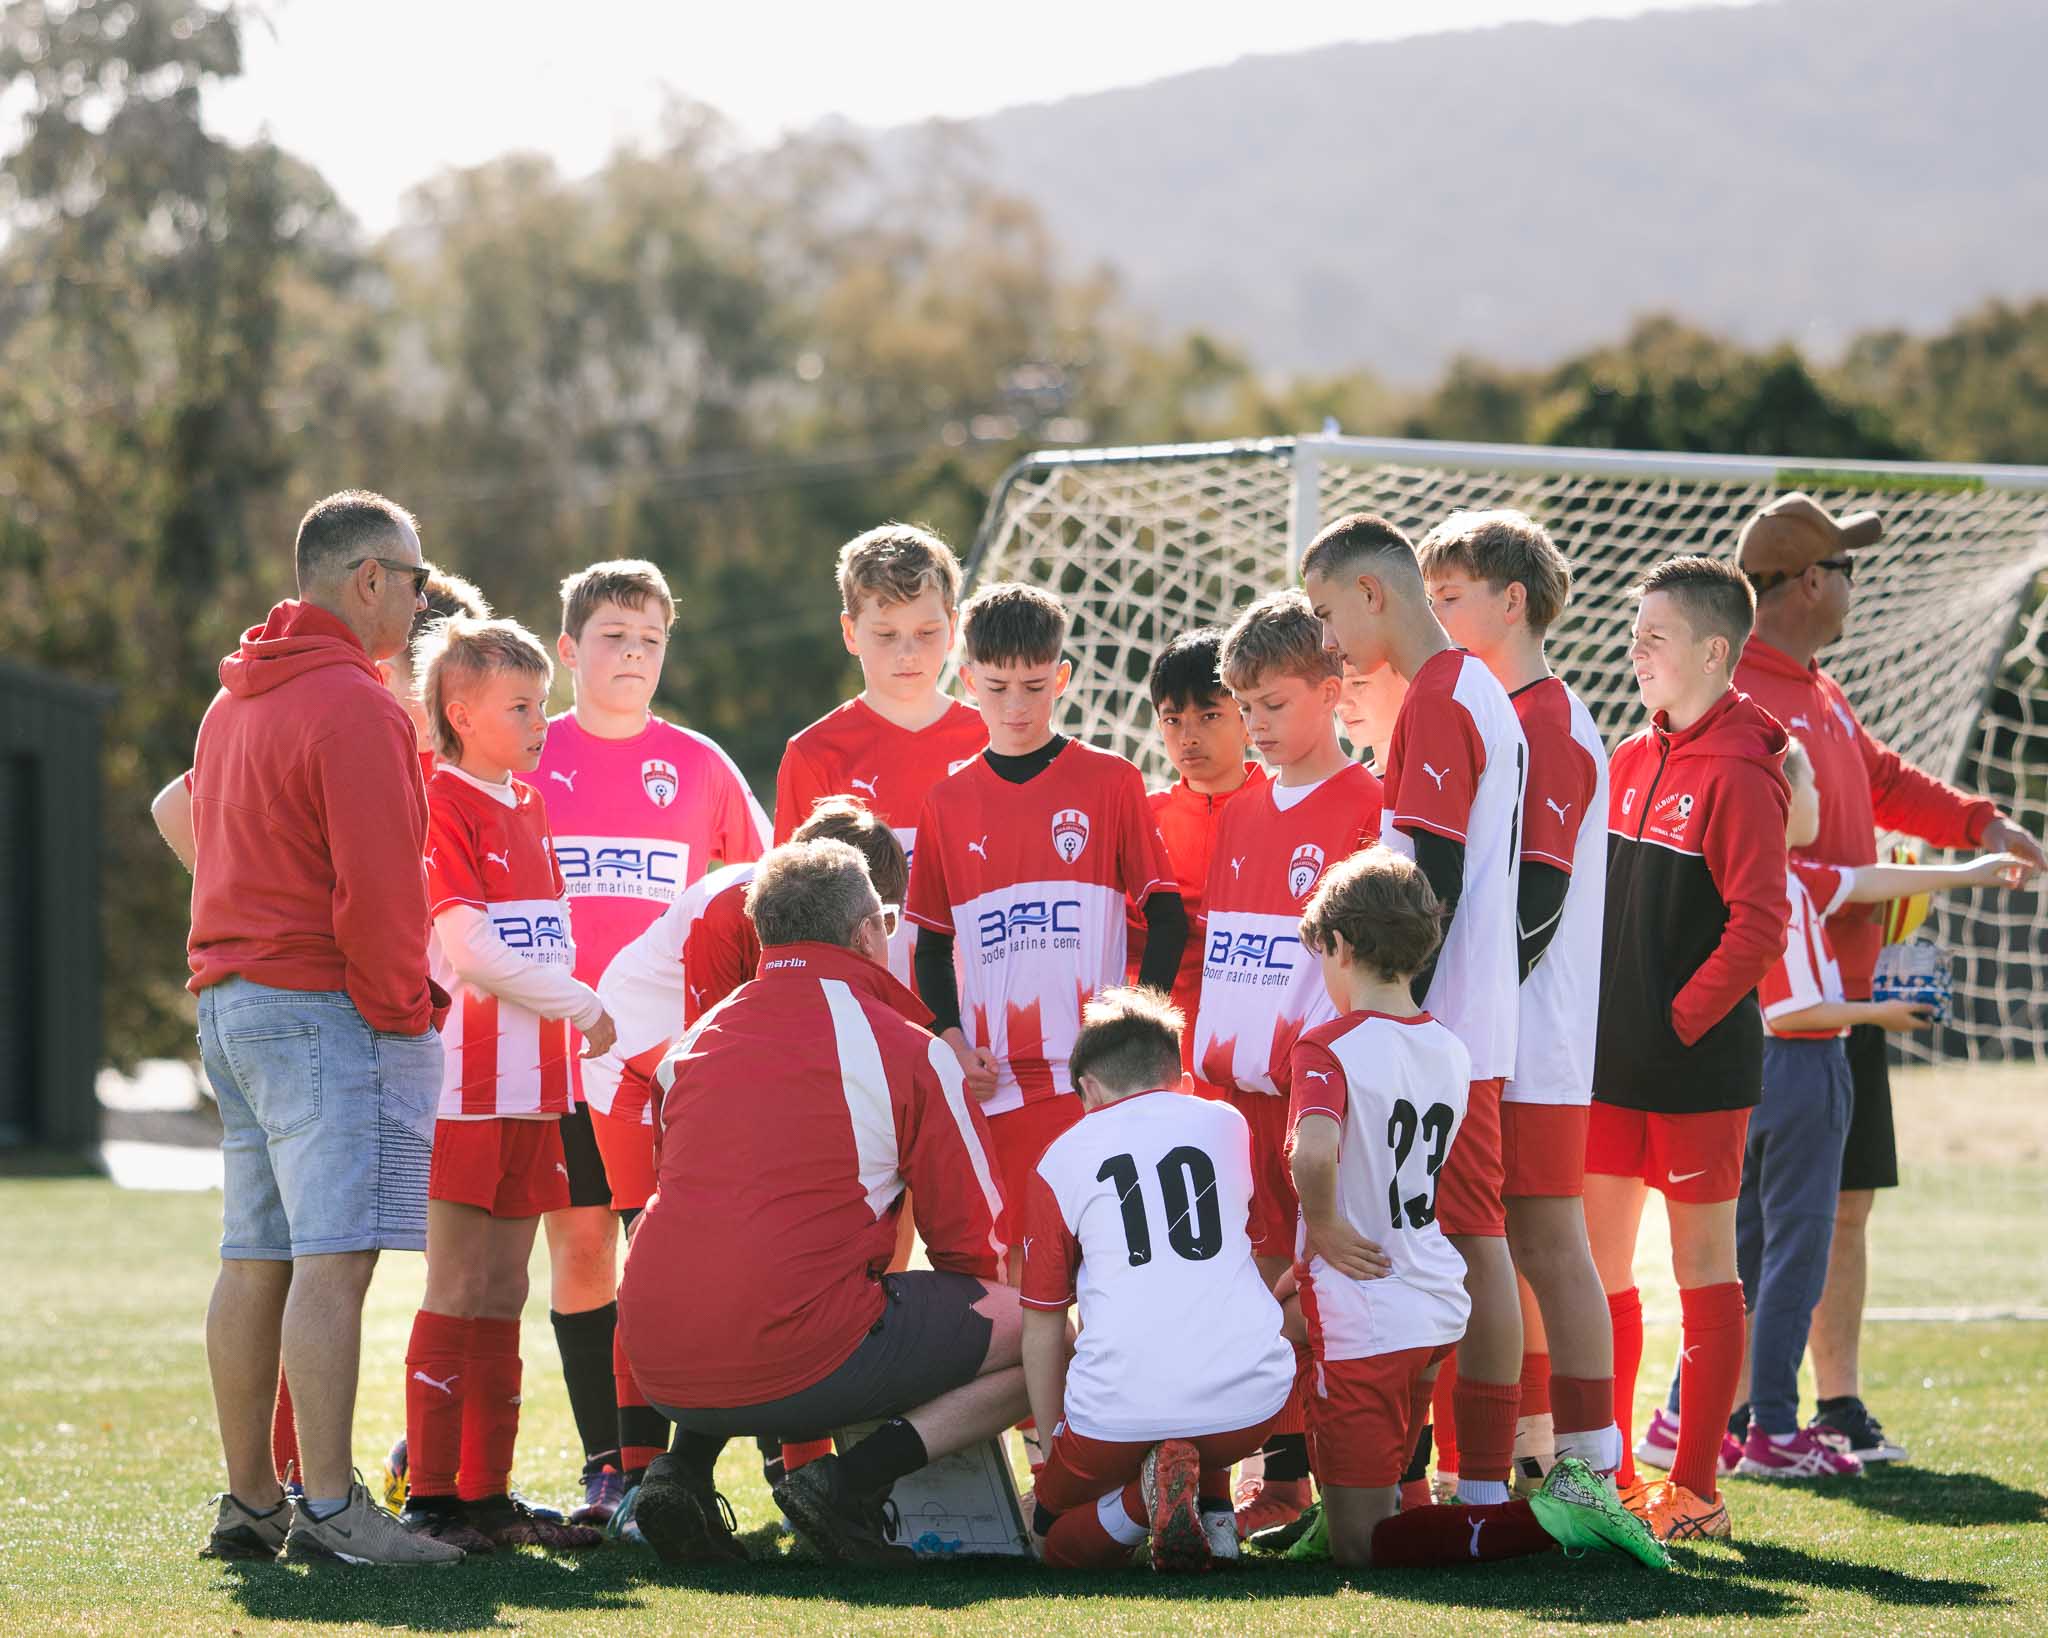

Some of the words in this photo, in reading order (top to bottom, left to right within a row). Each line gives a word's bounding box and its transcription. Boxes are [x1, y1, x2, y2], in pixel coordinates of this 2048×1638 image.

[565, 881, 592, 894] order
[597, 882, 643, 895] marine
[493, 916, 567, 948] BM
[978, 901, 1081, 947] BMC
[765, 958, 807, 970] marlin
[1208, 931, 1300, 969] BMC
[1261, 973, 1290, 987] centre
[1387, 1098, 1455, 1230] 23
[1096, 1145, 1223, 1267] 10
